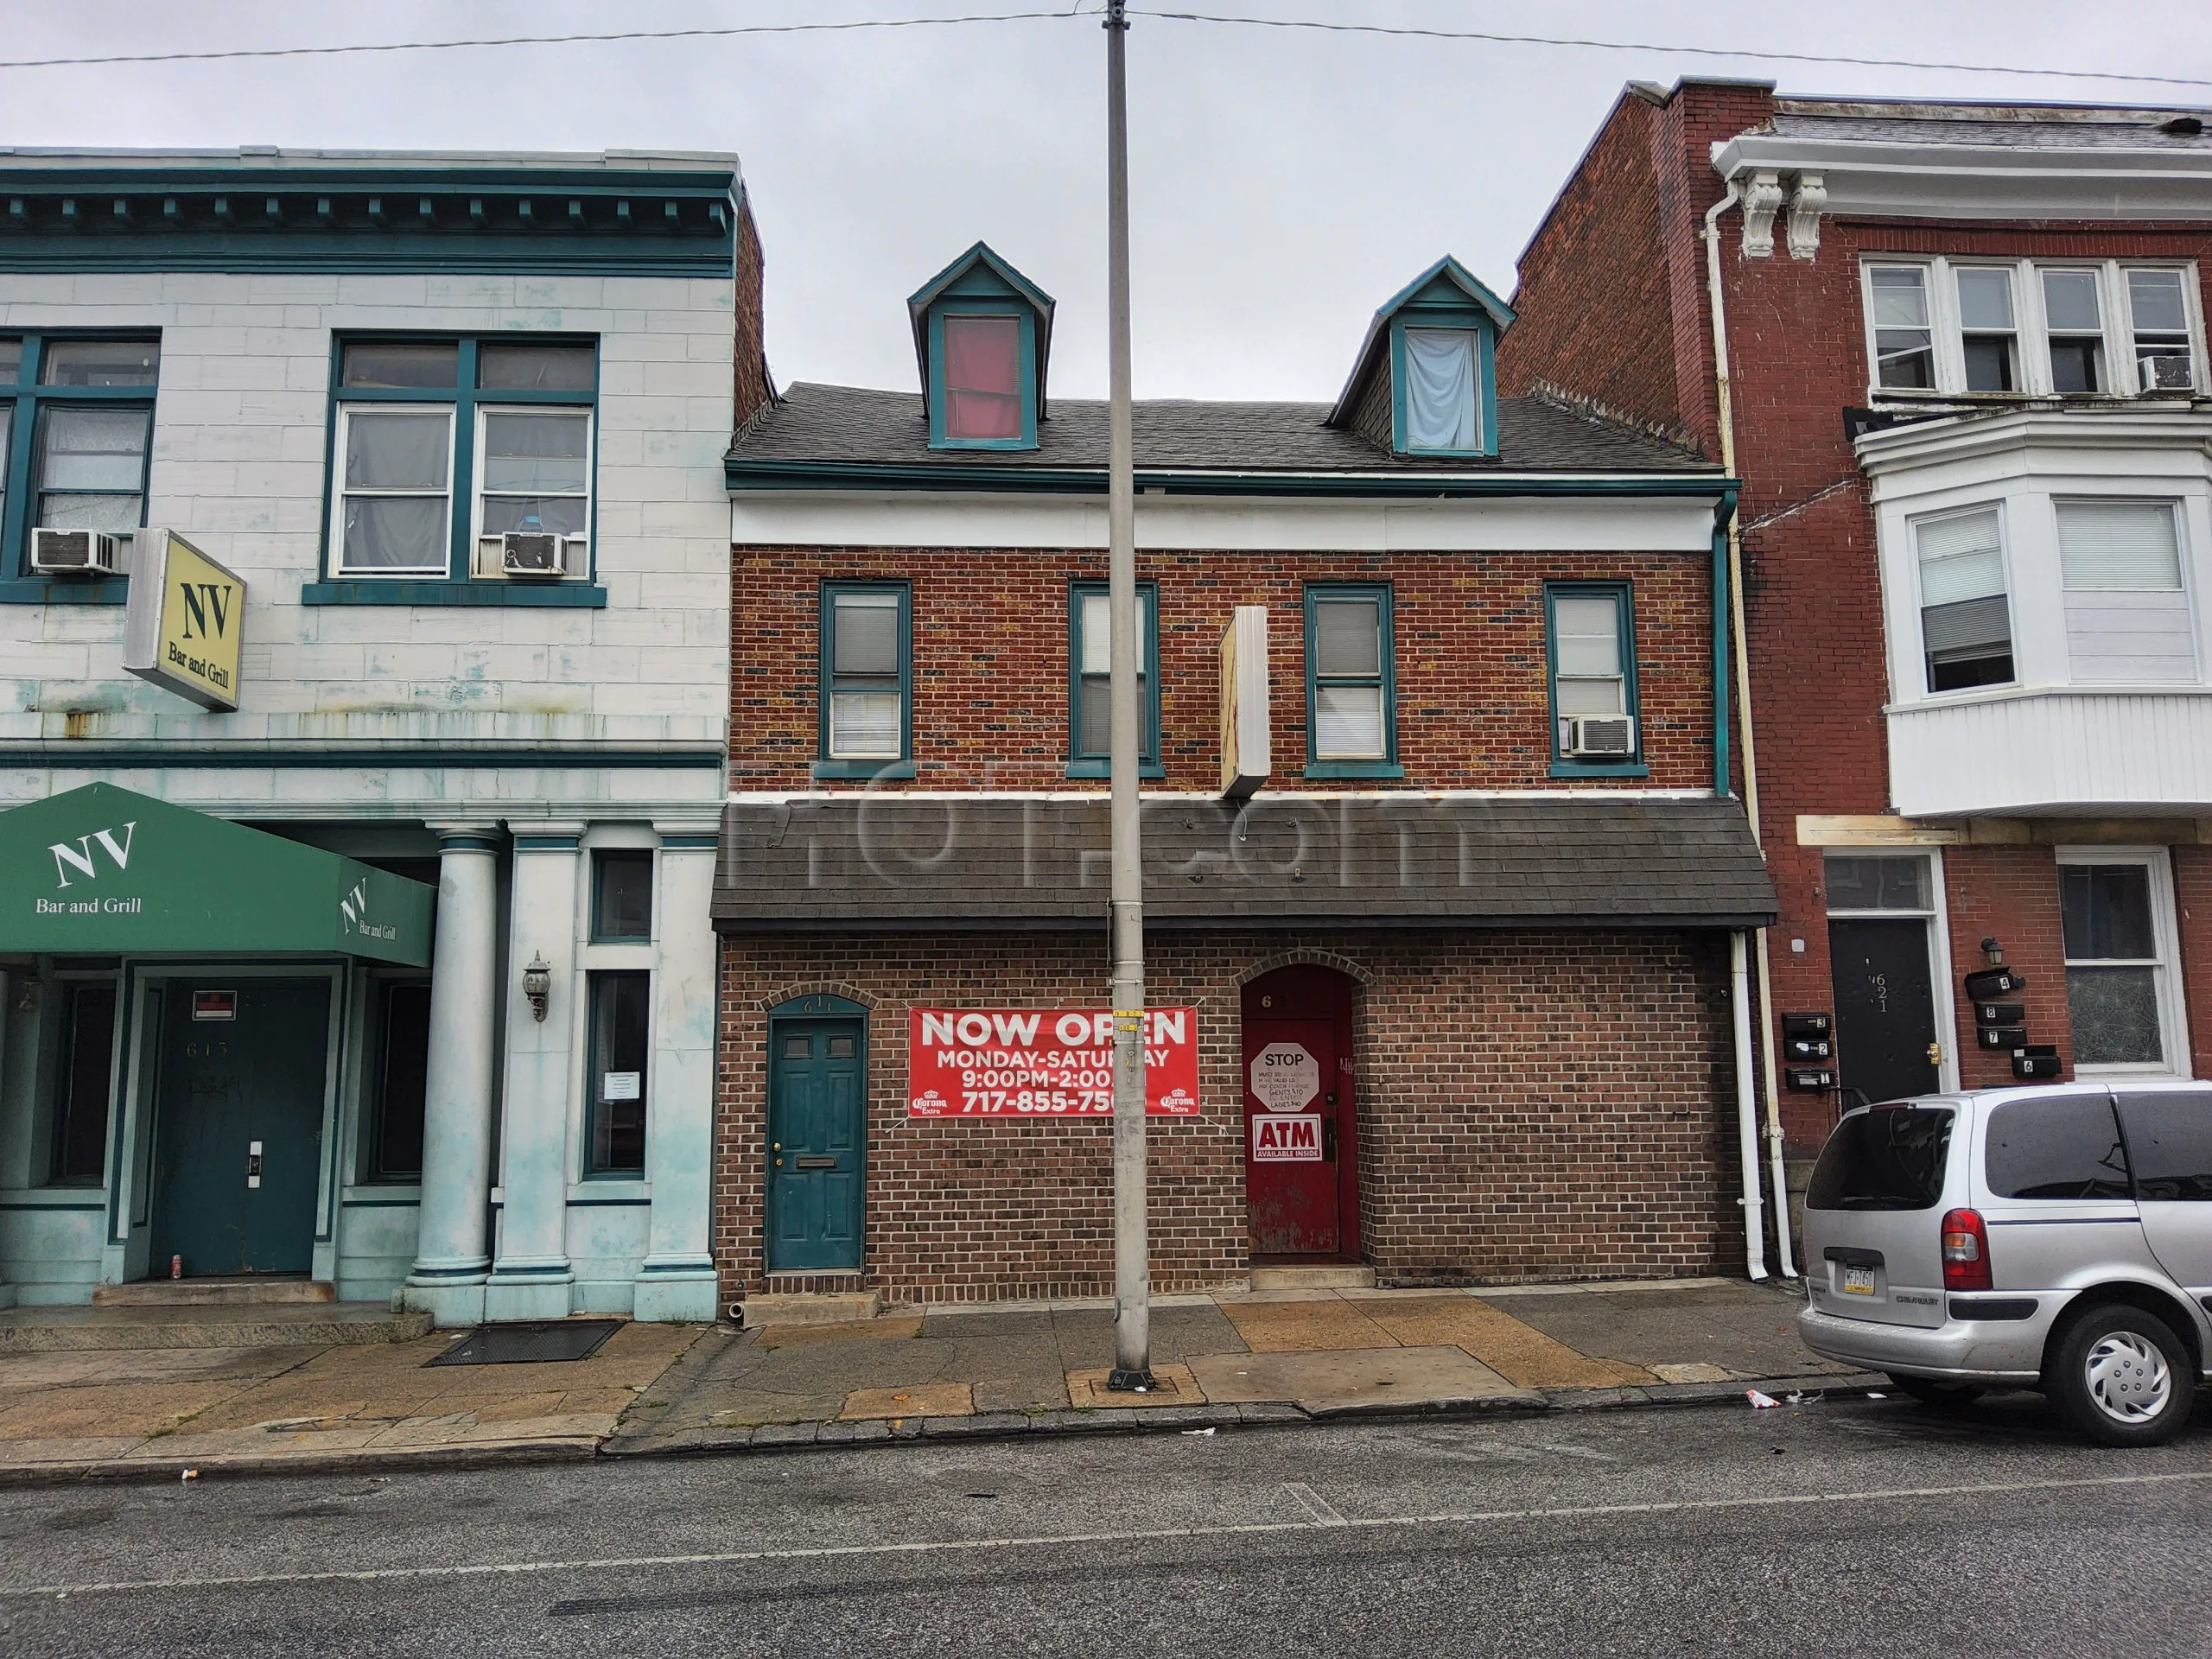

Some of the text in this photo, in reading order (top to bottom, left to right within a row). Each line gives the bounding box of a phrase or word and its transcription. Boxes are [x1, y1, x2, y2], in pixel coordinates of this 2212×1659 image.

[181, 582, 232, 639] NV
[168, 641, 229, 689] Bar and Grill
[47, 821, 137, 888] NV
[35, 898, 141, 913] Bar and Grill
[340, 876, 366, 935] NV
[359, 919, 396, 940] Bar and Grill
[2001, 978, 2009, 988] 4
[1877, 973, 1887, 1012] 621
[1987, 1007, 1994, 1017] 8
[922, 1013, 1040, 1046] NOW
[1817, 1018, 1825, 1027] 3
[1990, 1033, 1997, 1043] 7
[1820, 1045, 1827, 1054] 2
[1265, 1053, 1304, 1066] STOP
[2025, 1061, 2032, 1071] 6
[962, 1070, 1147, 1089] 9:00PM-2:00
[912, 1097, 948, 1109] Corona
[1160, 1096, 1195, 1108] Corona
[1259, 1122, 1315, 1147] ATM
